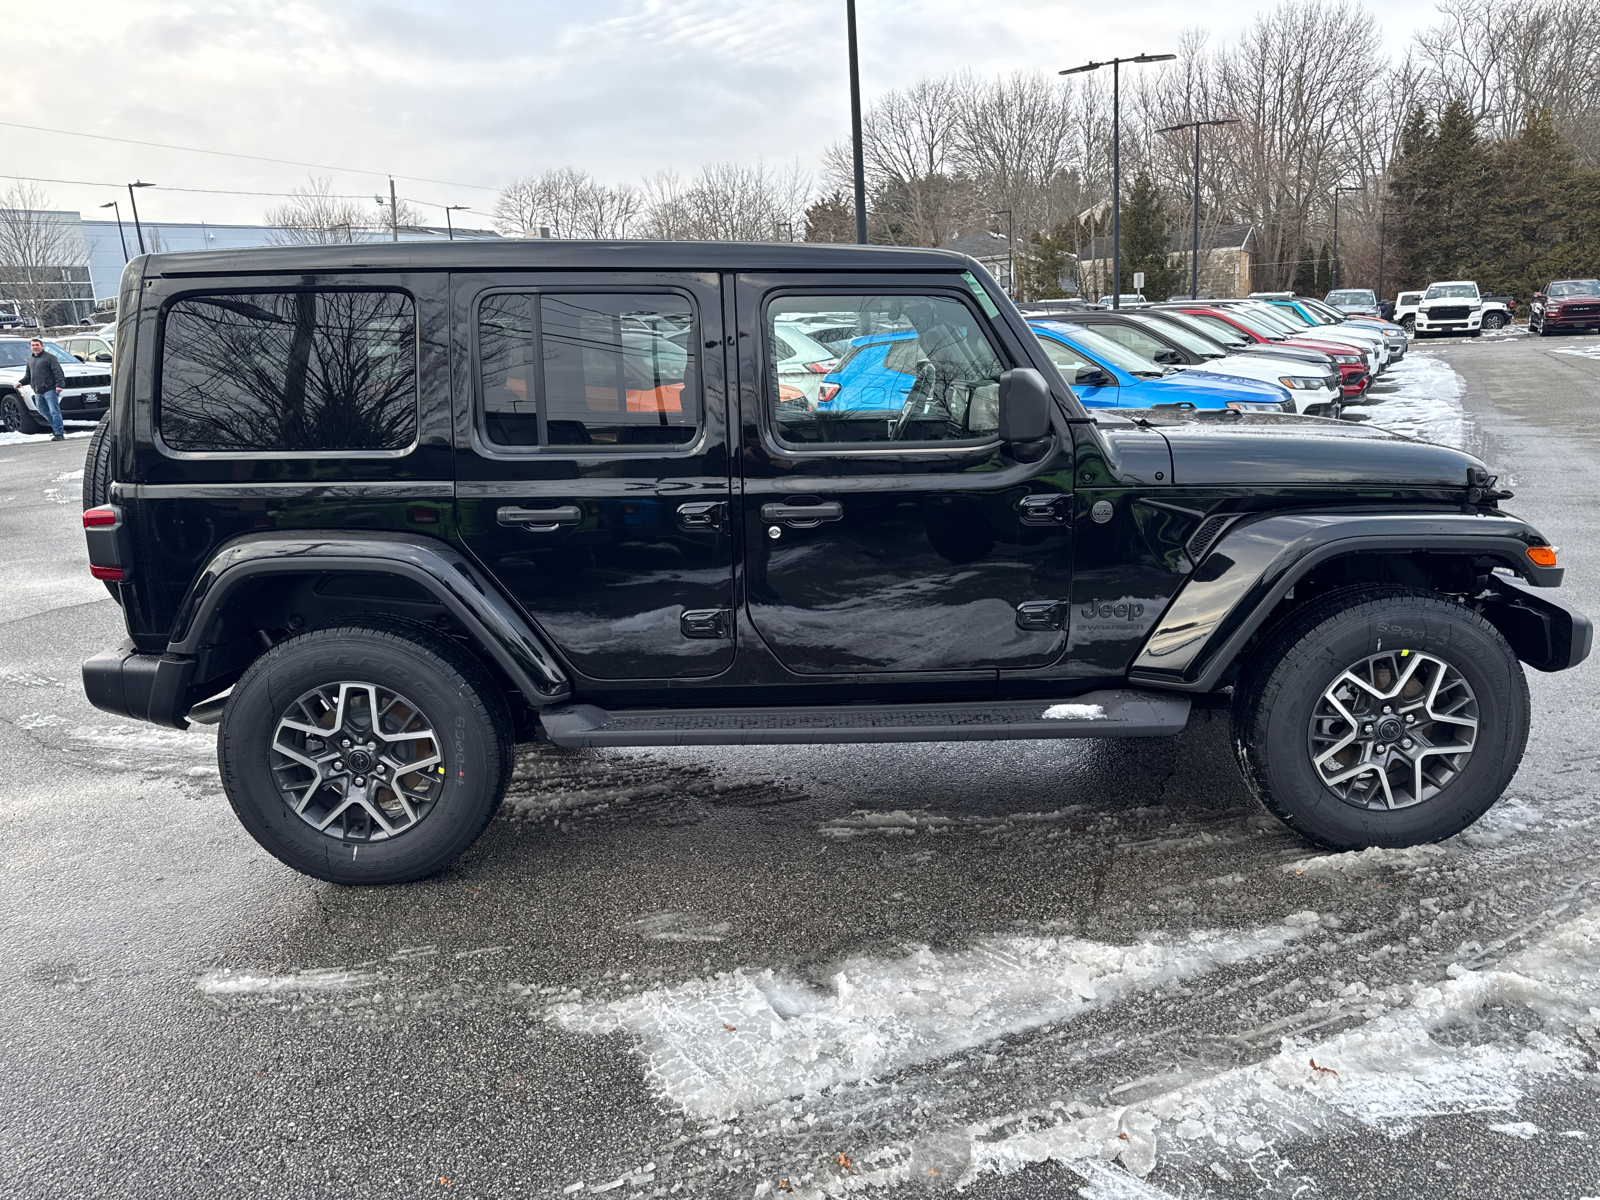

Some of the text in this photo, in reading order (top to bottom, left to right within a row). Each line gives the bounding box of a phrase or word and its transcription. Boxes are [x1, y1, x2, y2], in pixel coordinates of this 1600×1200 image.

[1081, 598, 1145, 622] Jeep
[267, 654, 411, 694] DUELER
[1438, 627, 1514, 790] BRIDGESTONE
[275, 815, 457, 872] BRIDGESTONE
